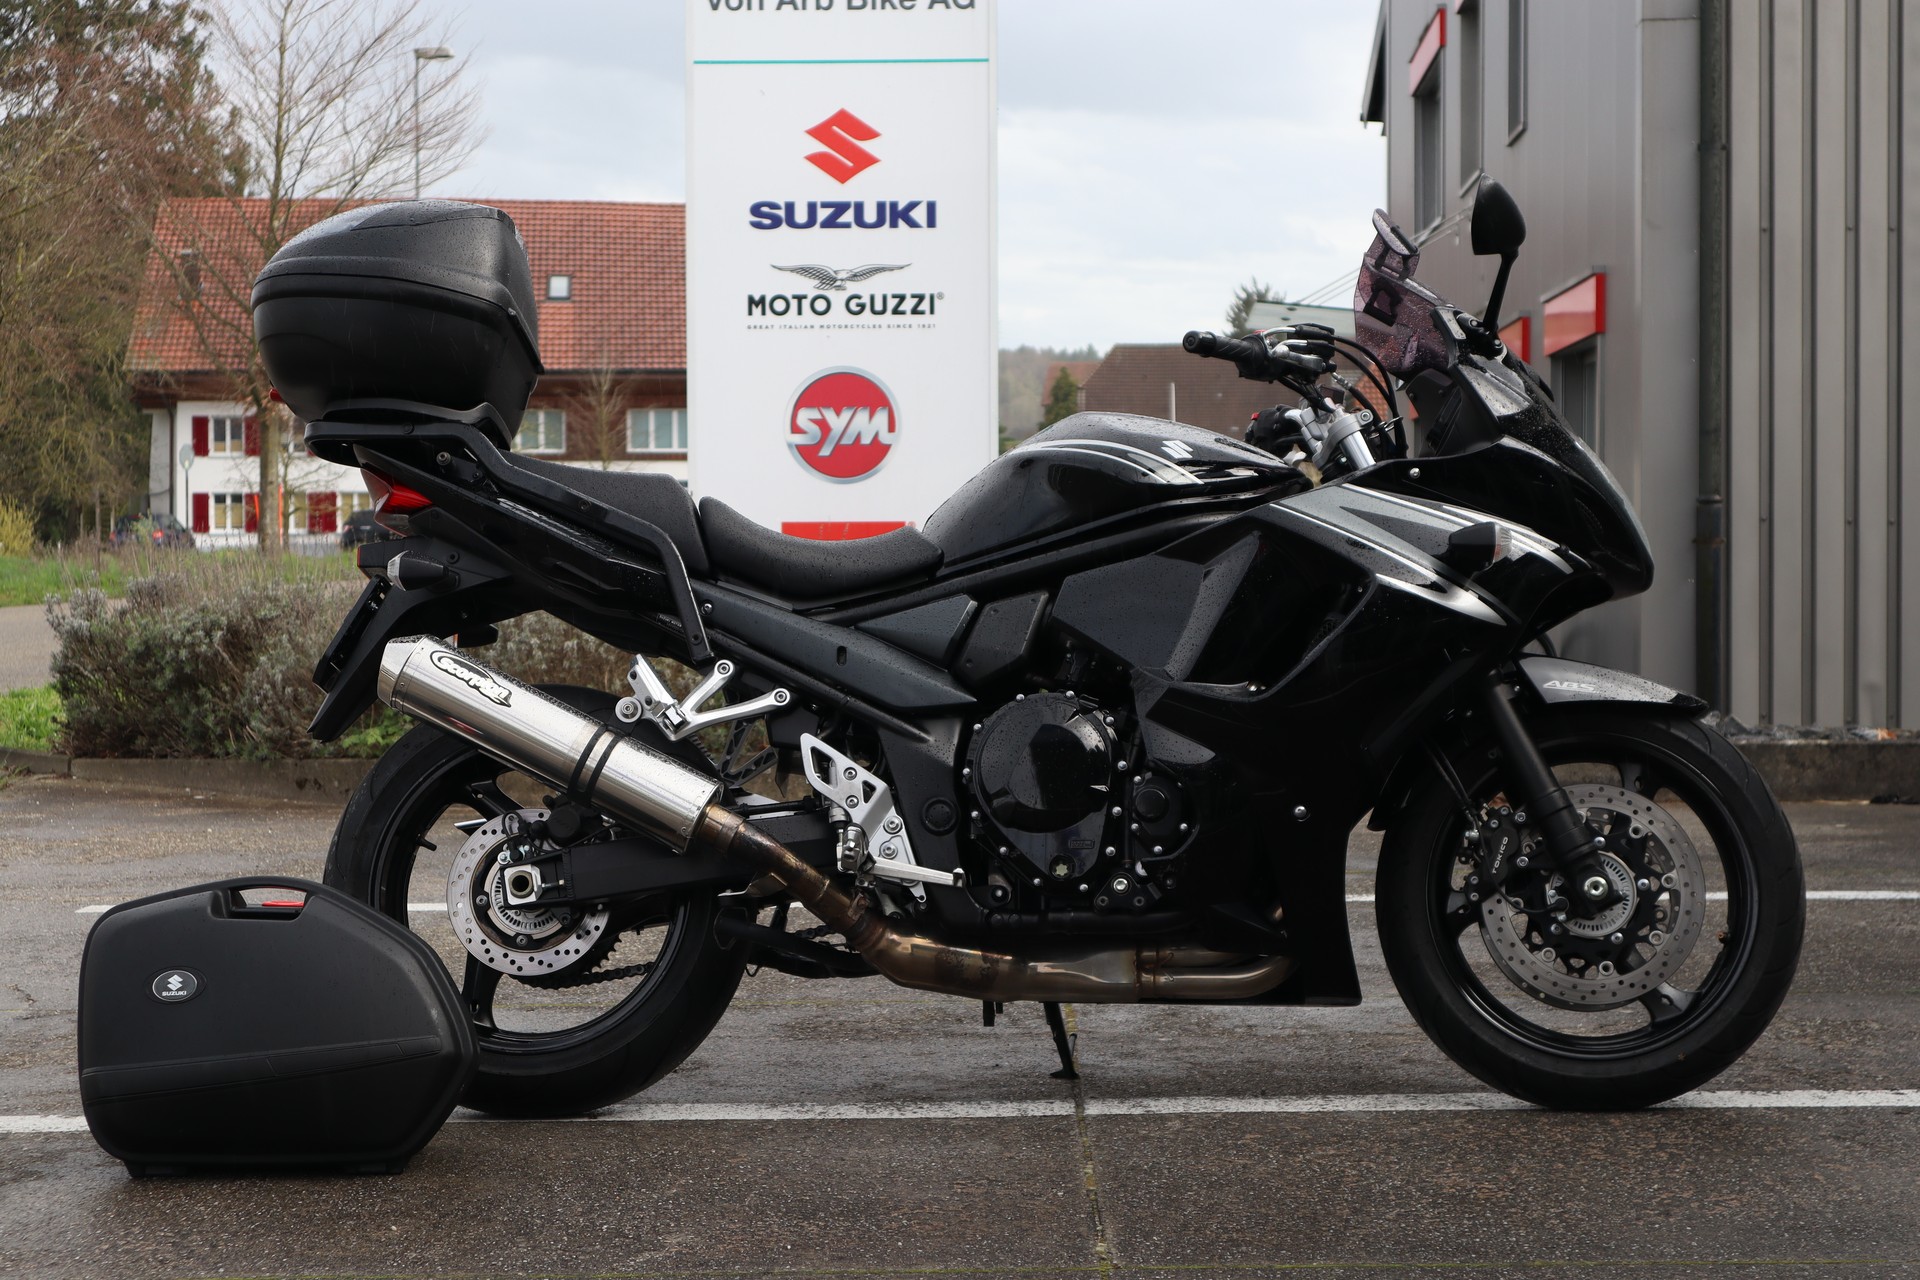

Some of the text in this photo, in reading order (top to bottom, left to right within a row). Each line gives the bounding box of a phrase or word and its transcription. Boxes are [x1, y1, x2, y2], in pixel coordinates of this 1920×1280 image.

[748, 200, 937, 230] SUZUKI
[747, 294, 832, 317] MOTO
[787, 406, 897, 458] SYM
[1542, 680, 1597, 692] ABS
[1491, 836, 1509, 874] TOKICO
